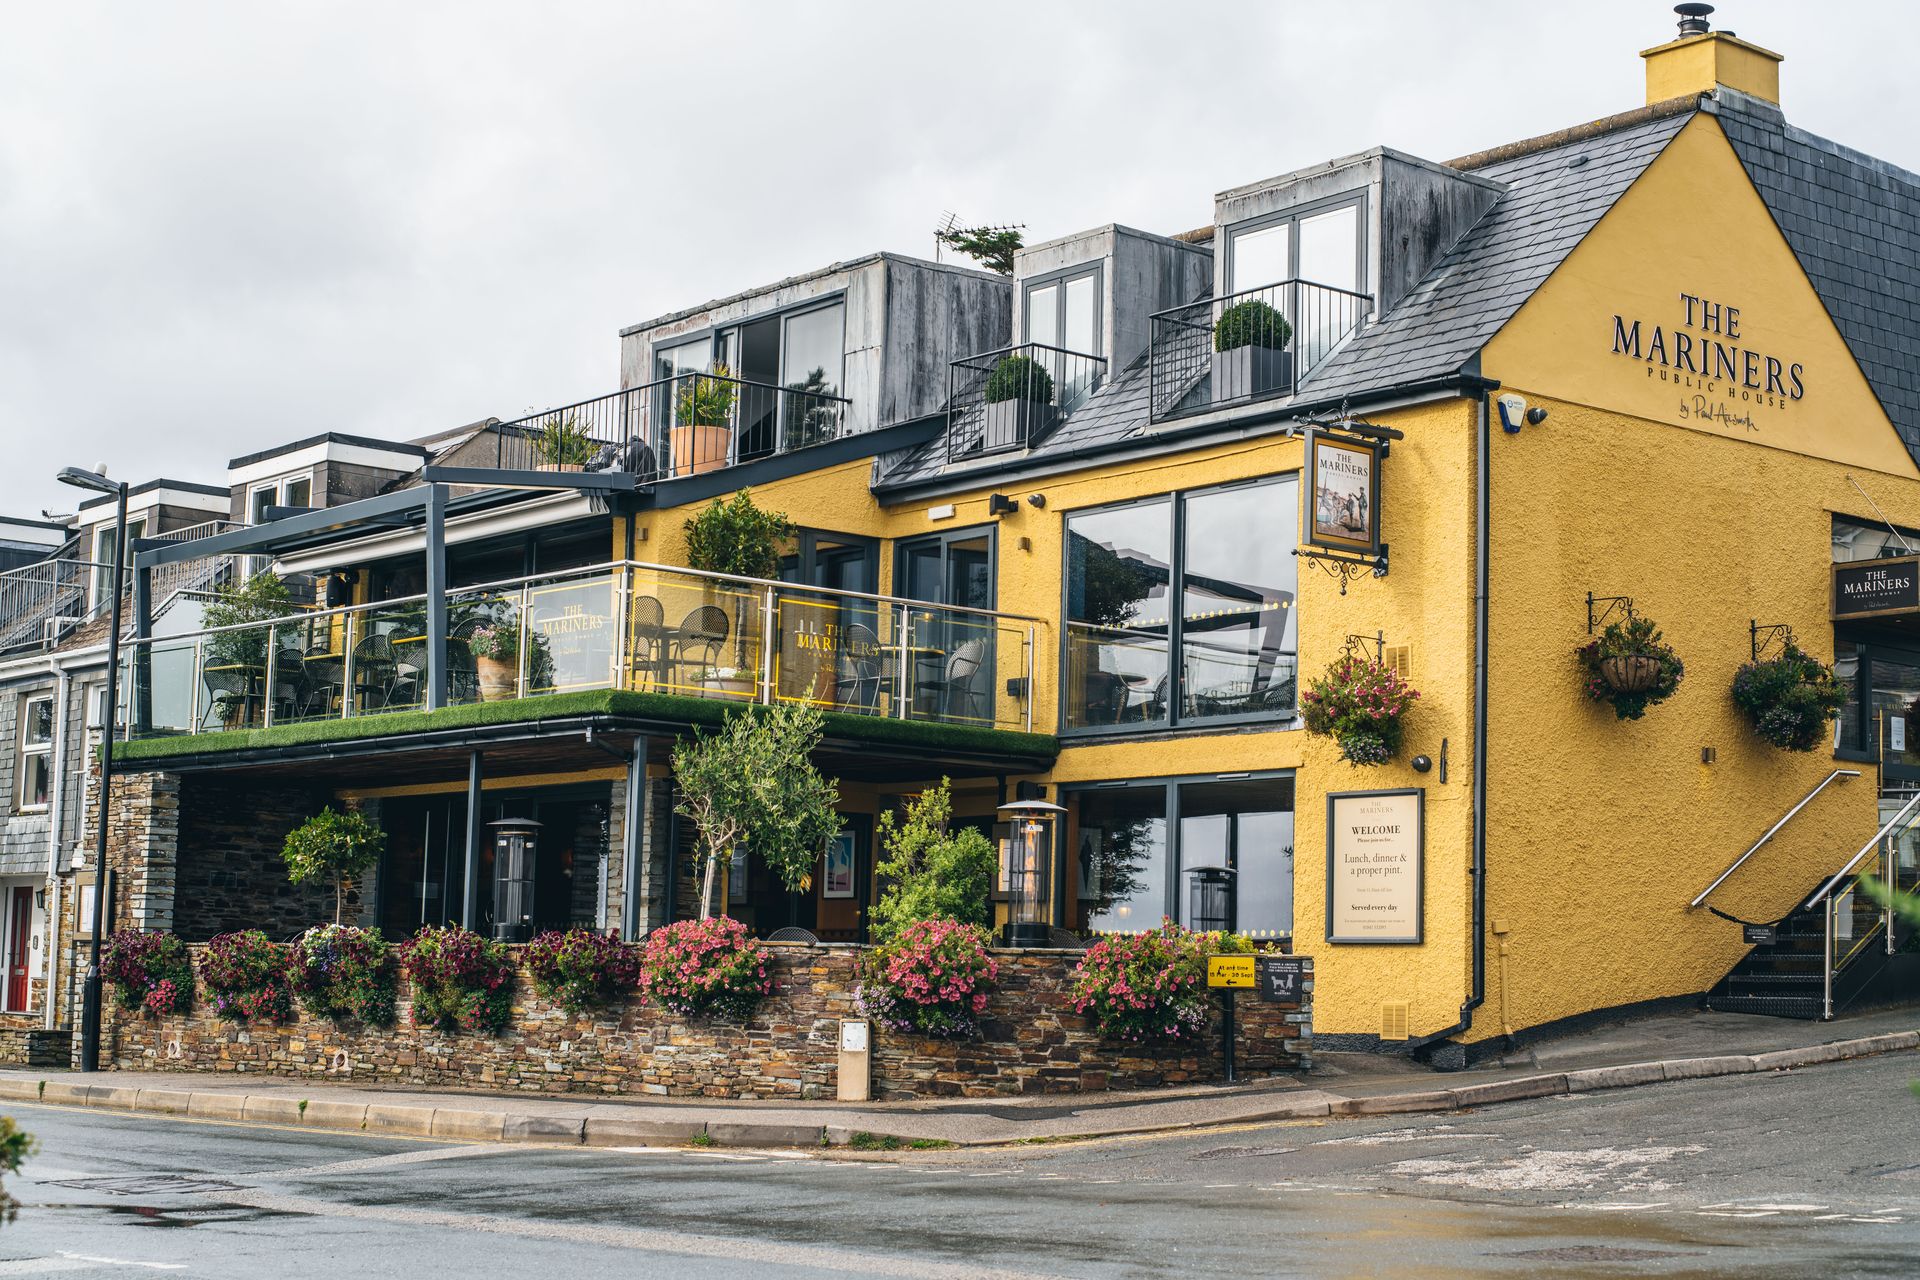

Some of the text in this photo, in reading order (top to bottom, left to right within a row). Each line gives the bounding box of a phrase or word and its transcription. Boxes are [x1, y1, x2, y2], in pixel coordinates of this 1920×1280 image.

[1680, 293, 1741, 339] THE
[1610, 314, 1804, 401] MARINERS
[1648, 367, 1785, 409] PUBLIC HOUSE
[1679, 398, 1689, 419] by
[1692, 394, 1713, 420] Paul
[1336, 453, 1352, 463] THE
[1320, 459, 1368, 476] MARINERS
[1866, 570, 1887, 580] THE
[1844, 577, 1910, 594] MARINERS
[564, 604, 583, 618] THE
[543, 615, 603, 636] MARINERS
[1351, 825, 1401, 835] WELCOME
[1344, 852, 1407, 864] Lunch, dinner &
[1356, 867, 1382, 878] proper
[1384, 865, 1402, 877] pint.
[1388, 904, 1398, 912] day
